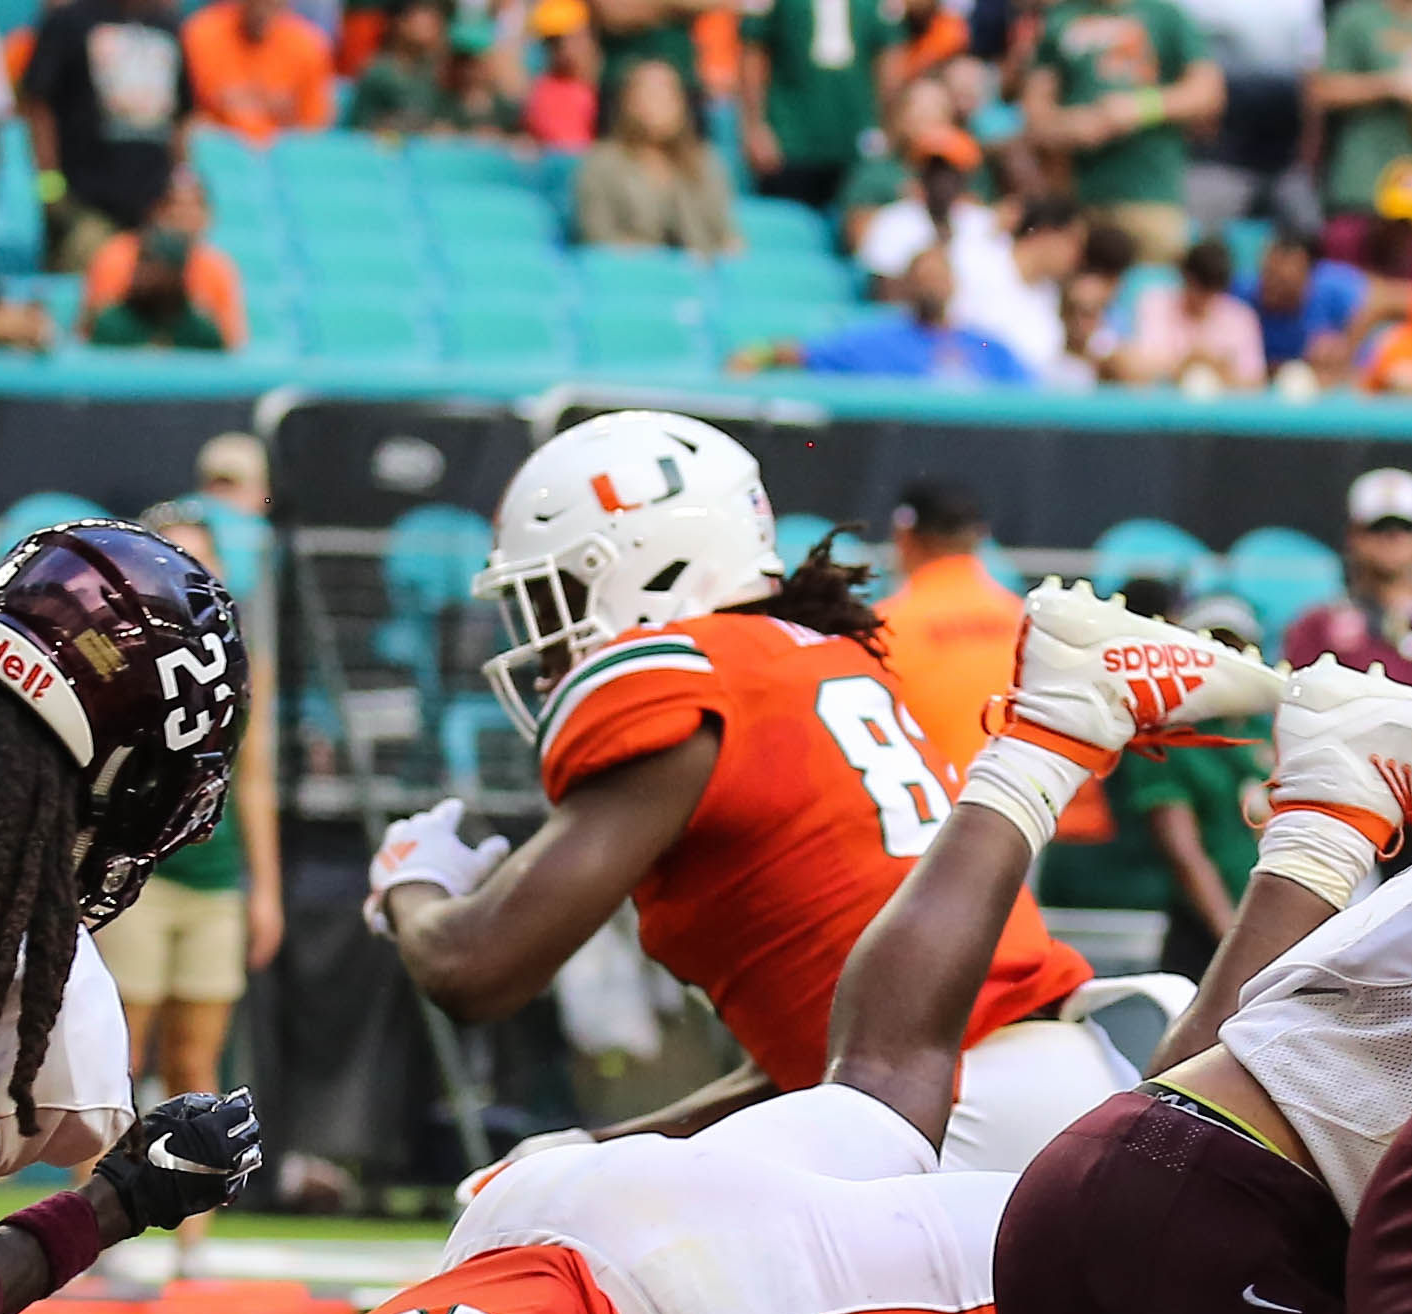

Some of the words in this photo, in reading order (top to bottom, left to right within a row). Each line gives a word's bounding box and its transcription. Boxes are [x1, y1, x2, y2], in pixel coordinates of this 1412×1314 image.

[590, 456, 685, 513] U
[154, 632, 239, 751] 23
[1103, 645, 1215, 679] adidas
[815, 674, 953, 858] 8
